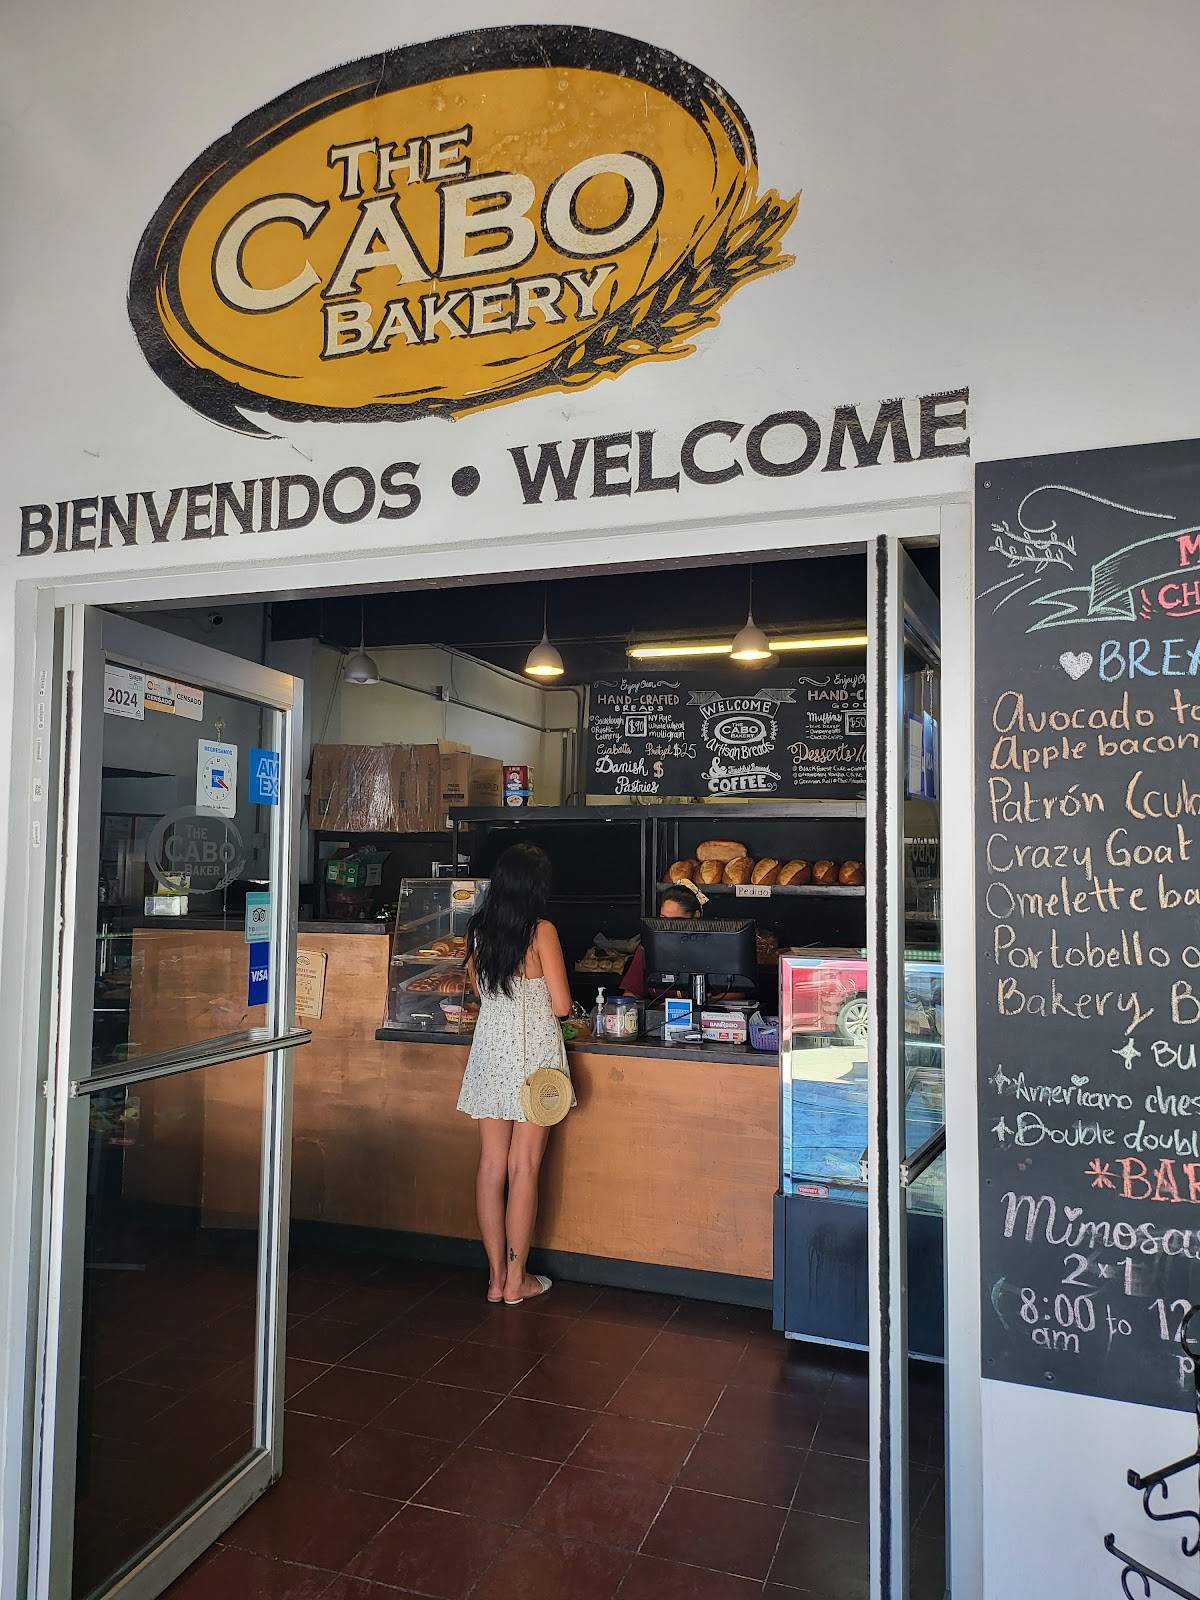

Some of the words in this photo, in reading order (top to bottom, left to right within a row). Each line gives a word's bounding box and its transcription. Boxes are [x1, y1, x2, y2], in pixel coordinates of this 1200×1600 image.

[328, 124, 472, 201] THE
[211, 150, 664, 314] CABO
[320, 263, 618, 361] BAKERY
[17, 462, 421, 557] BIENVENIDOS
[506, 386, 971, 504] WELCOME
[107, 687, 138, 708] 2024
[176, 693, 202, 706] CENSADO
[597, 694, 680, 705] HAND-CRAFTED
[702, 699, 772, 717] WELCOME
[992, 689, 1154, 733] Avocado
[721, 726, 759, 734] CABO
[673, 742, 697, 759] $25
[741, 738, 774, 759] Breads
[990, 735, 1087, 773] Apple
[1098, 732, 1199, 757] bacon
[595, 755, 648, 776] Danish
[653, 761, 664, 778] $
[615, 776, 659, 794] Pastries
[708, 775, 766, 792] COFFEE
[988, 776, 1105, 824] Patrón
[186, 824, 208, 840] THE
[165, 834, 236, 863] CABO
[986, 833, 1092, 881] Crazy
[1105, 823, 1193, 867] Goat
[986, 876, 1148, 919] Omelette
[993, 924, 1171, 969] Portobello
[251, 969, 268, 983] VISA
[1151, 1040, 1197, 1070] BU
[1015, 1111, 1116, 1147] Double
[1019, 1287, 1096, 1332] 8:00
[1105, 1304, 1132, 1341] to
[1031, 1327, 1080, 1353] am
